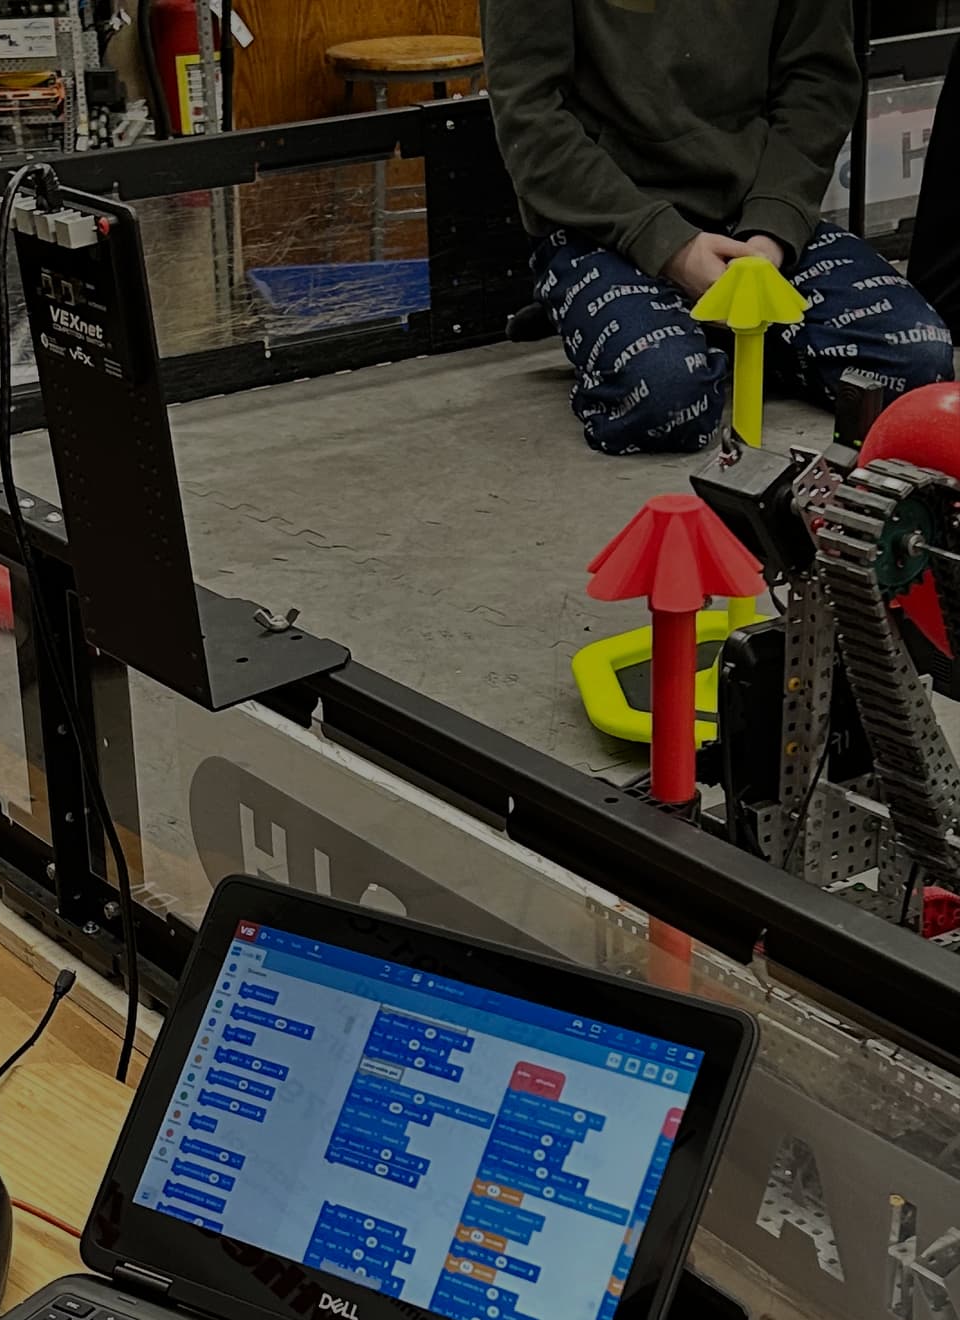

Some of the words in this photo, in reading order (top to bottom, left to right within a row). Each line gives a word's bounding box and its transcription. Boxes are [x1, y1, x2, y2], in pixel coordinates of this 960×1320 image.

[586, 284, 660, 318] PATRIOTS
[49, 304, 104, 340] VEXnet
[68, 346, 95, 368] VEX
[612, 325, 687, 373] PATRIOTS
